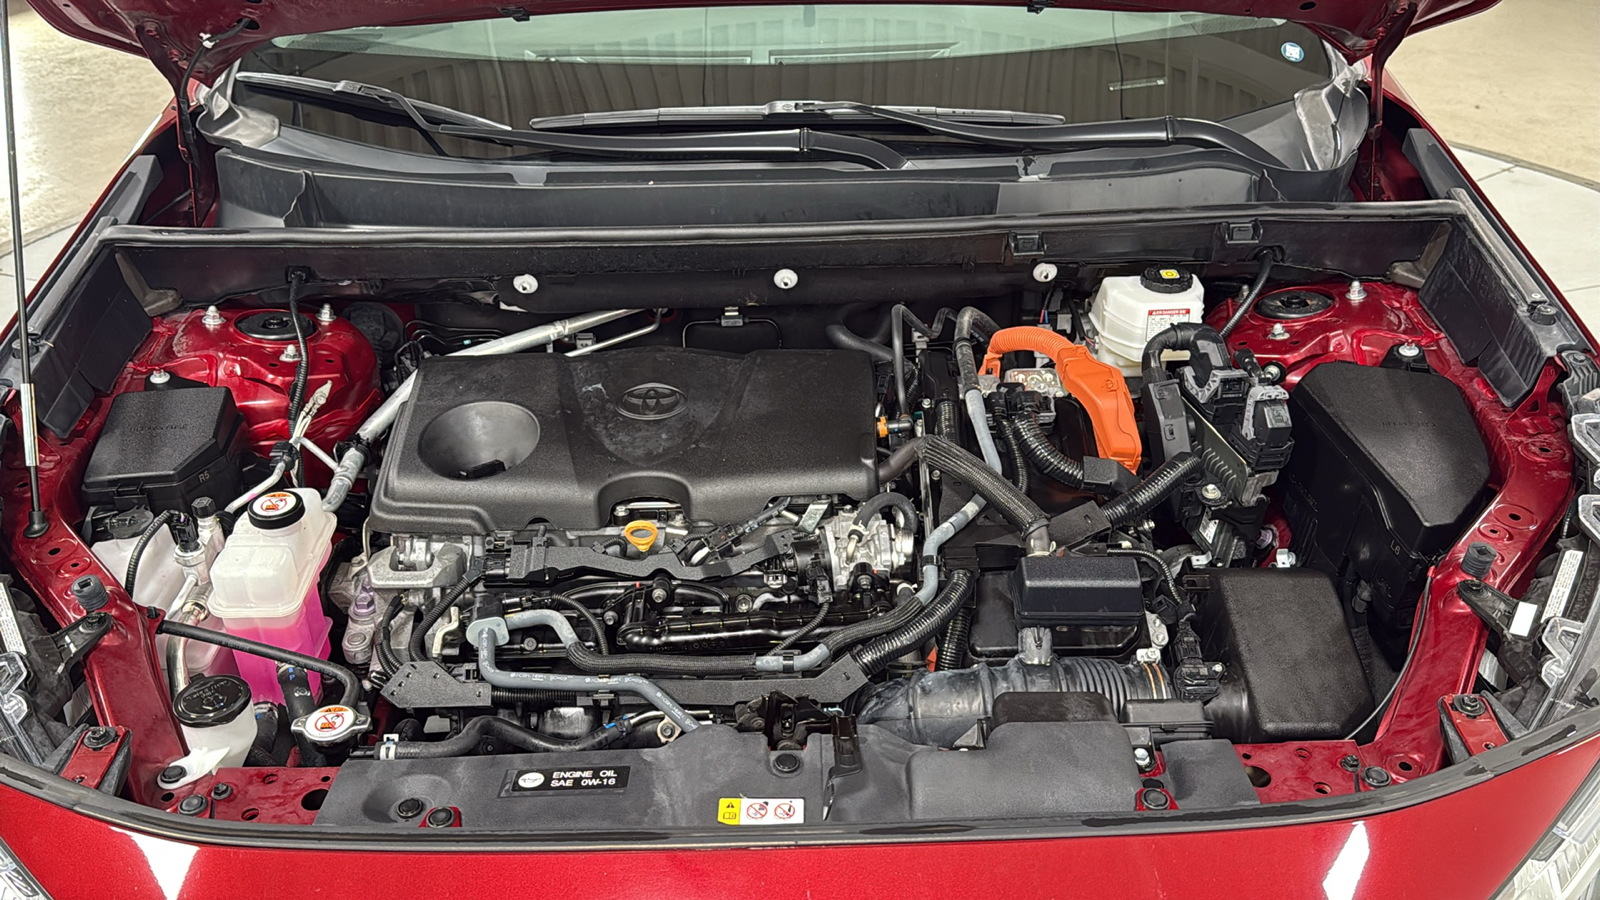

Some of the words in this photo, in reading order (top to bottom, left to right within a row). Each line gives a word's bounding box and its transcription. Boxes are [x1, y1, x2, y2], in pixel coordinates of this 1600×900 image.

[198, 470, 210, 483] R5
[552, 770, 593, 779] ENGINE
[599, 769, 618, 778] OIL
[550, 779, 574, 787] SAE
[580, 778, 616, 786] 0W-16
